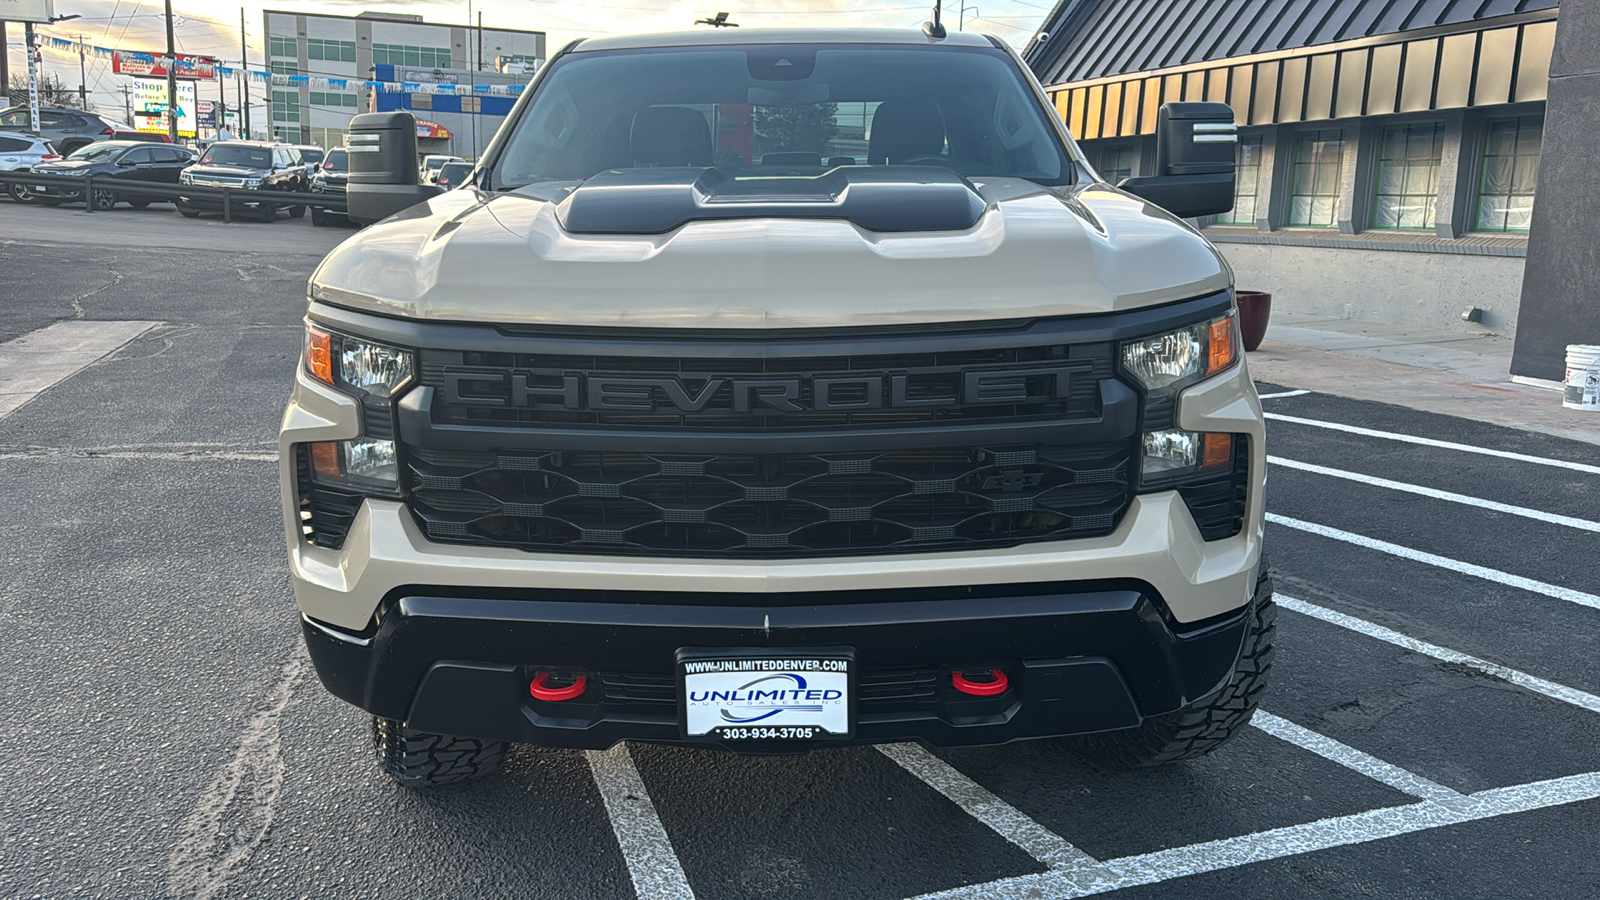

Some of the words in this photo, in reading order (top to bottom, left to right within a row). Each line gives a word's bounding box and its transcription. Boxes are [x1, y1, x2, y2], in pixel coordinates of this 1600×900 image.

[134, 81, 163, 92] Shop
[175, 82, 193, 93] ere
[416, 120, 438, 128] TRANCE
[442, 363, 1094, 414] CHEVROLET
[685, 660, 847, 673] WWWUNLIMITEDDENVER.COM
[689, 690, 843, 701] UNLIMITED
[723, 728, 813, 739] 303-934-3705
